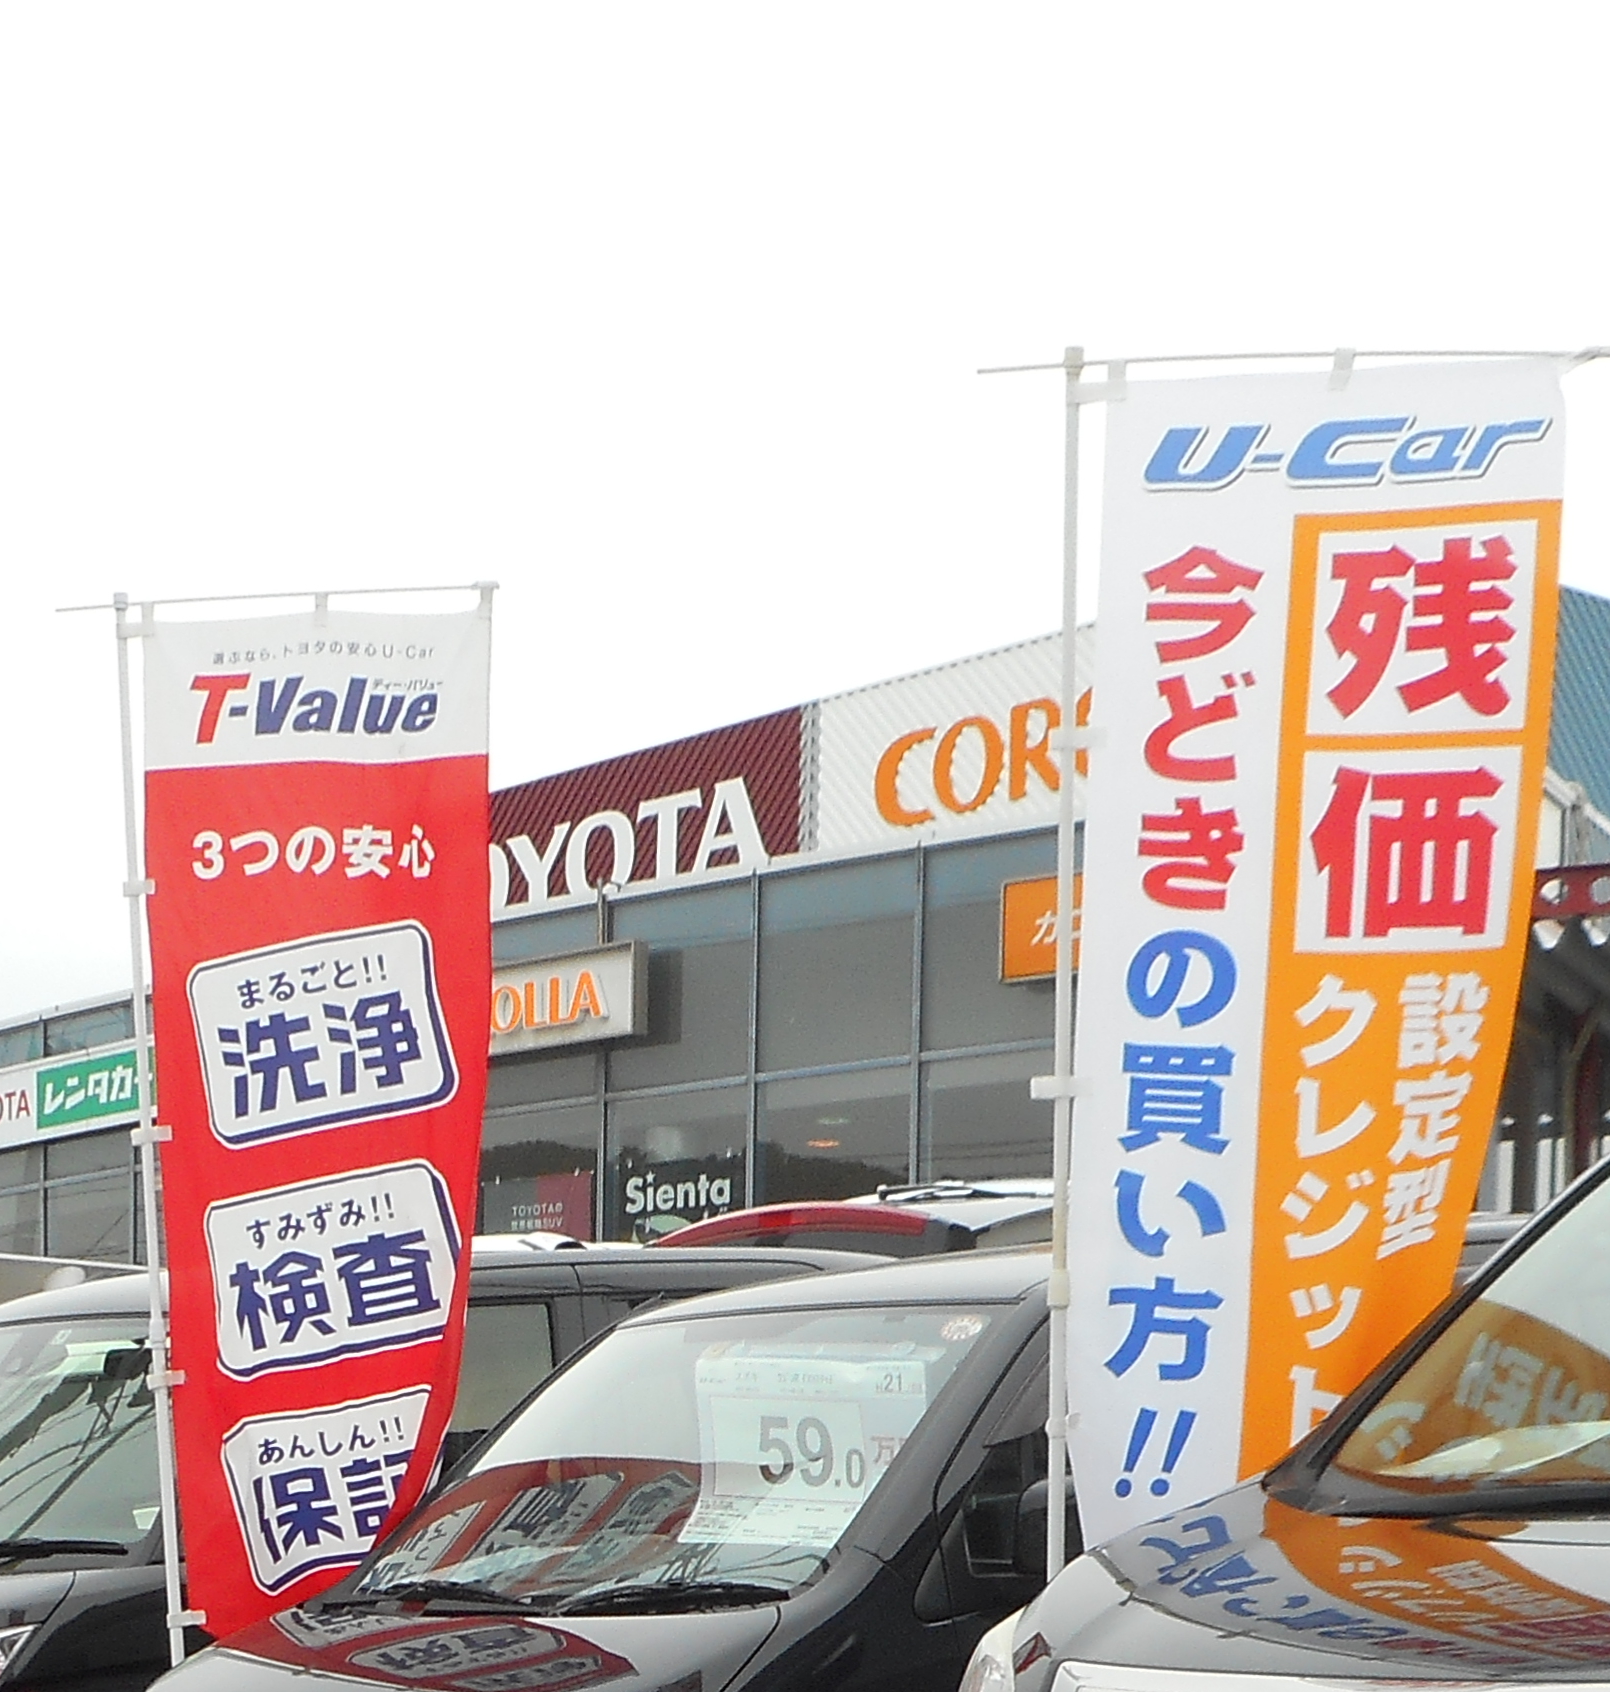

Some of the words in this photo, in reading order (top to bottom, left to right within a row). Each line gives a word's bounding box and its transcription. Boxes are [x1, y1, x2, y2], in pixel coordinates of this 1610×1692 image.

[1143, 413, 1555, 490] U-Car
[190, 672, 440, 745] T-Value
[191, 823, 437, 880] 3つの安心
[236, 953, 389, 1010] まるごと!!
[217, 990, 424, 1120] 洗浄
[246, 1192, 395, 1250] すみずみ!!
[624, 1170, 732, 1215] Sienta
[229, 1229, 443, 1352] 検査
[257, 1415, 405, 1466] あんしん!!
[758, 1415, 866, 1489] 59.0
